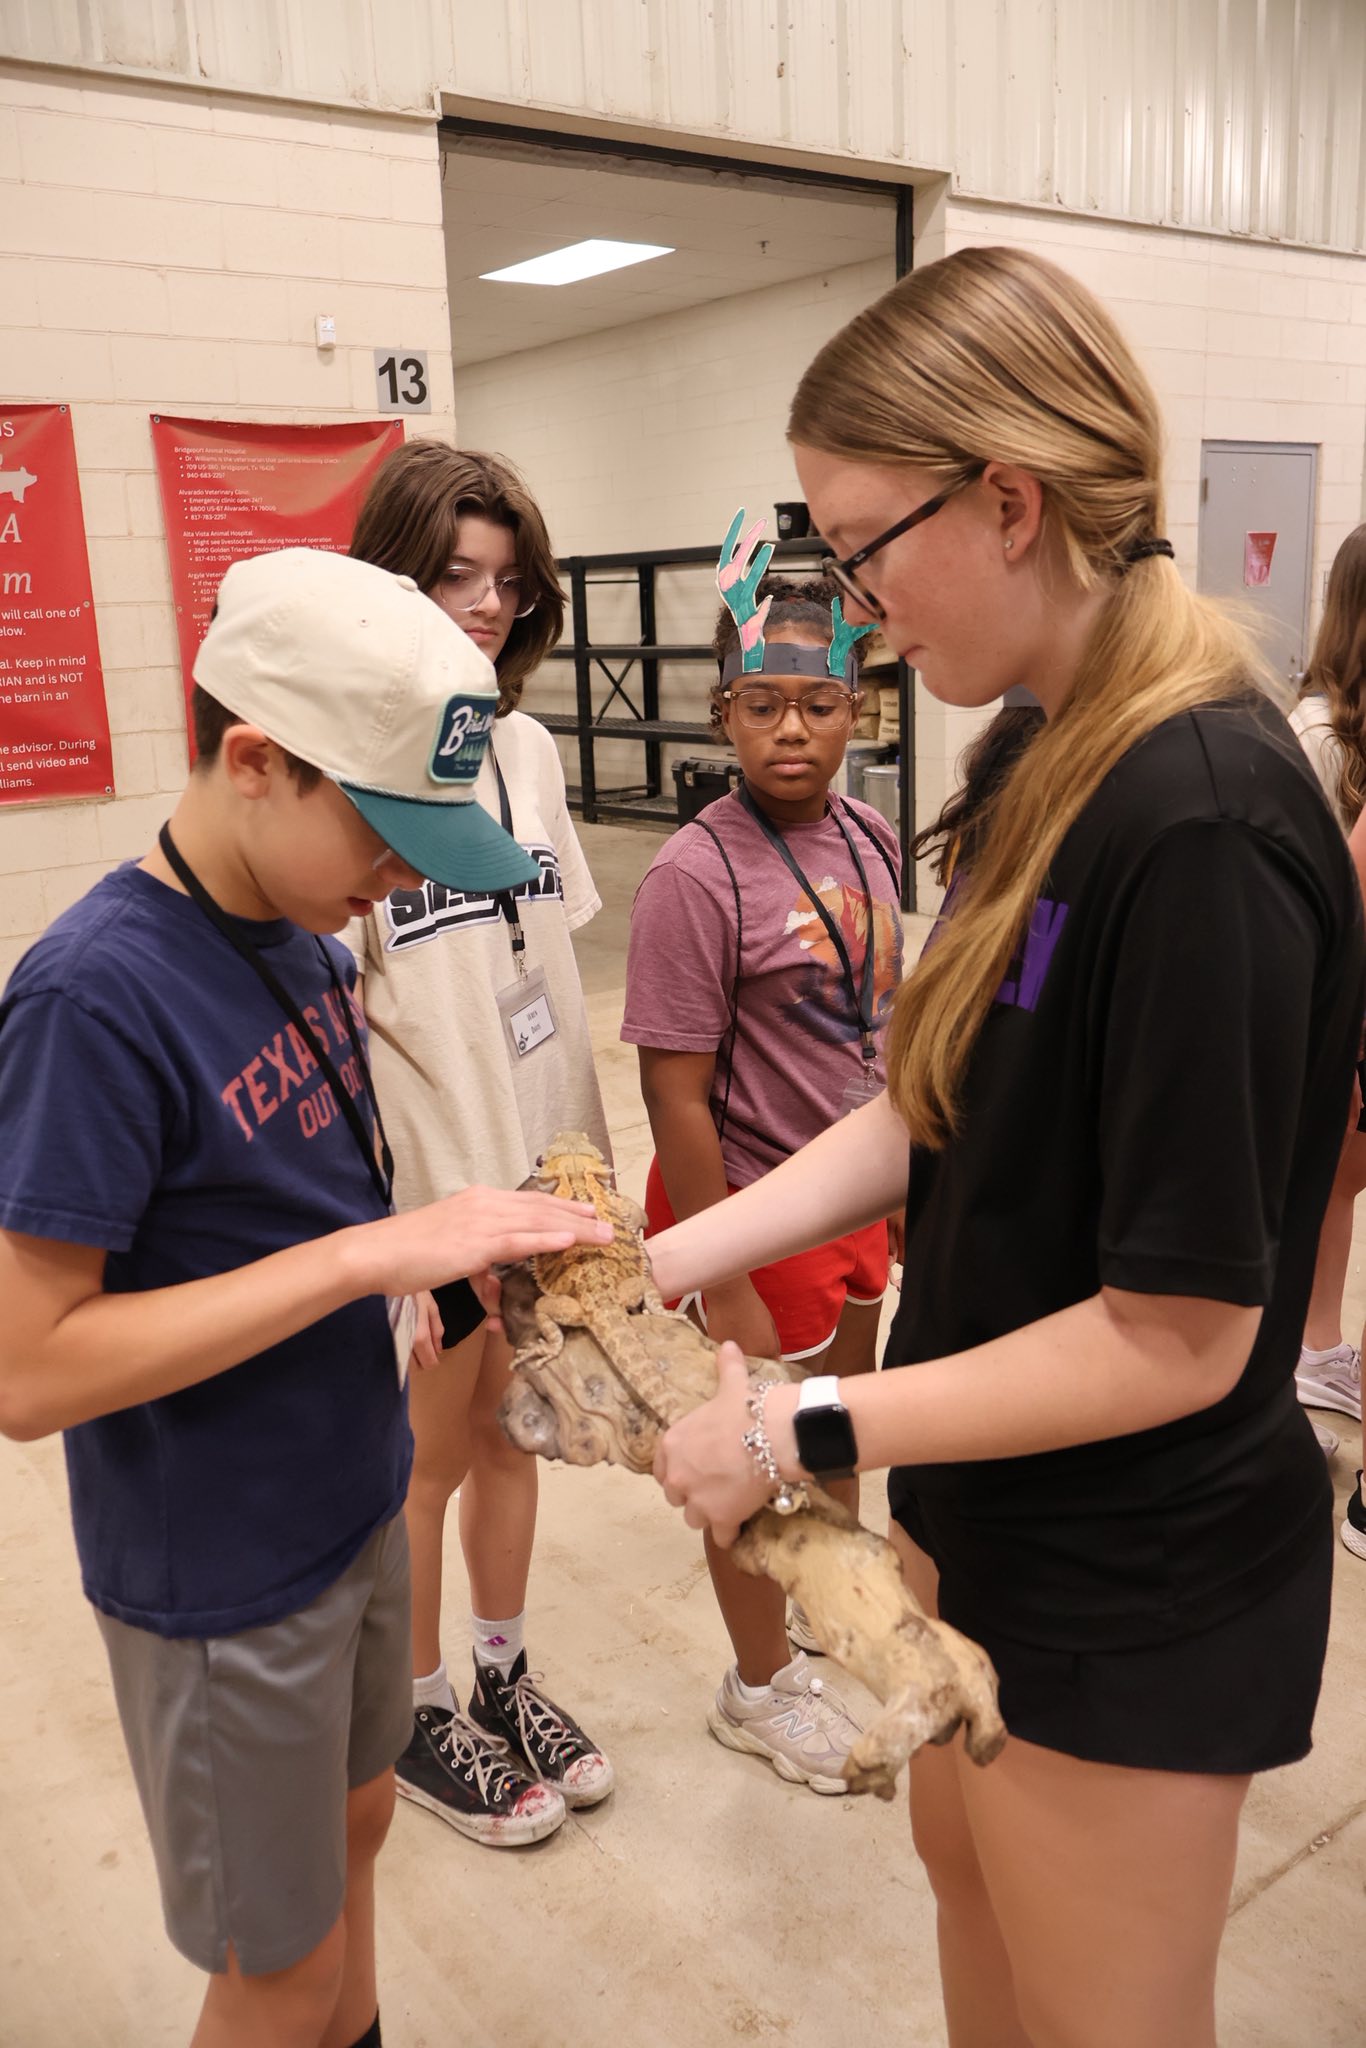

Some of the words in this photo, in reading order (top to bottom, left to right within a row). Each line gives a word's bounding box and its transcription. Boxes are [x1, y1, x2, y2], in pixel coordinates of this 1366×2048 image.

[378, 356, 427, 405] 13
[189, 497, 220, 505] Emergency
[267, 537, 284, 545] during
[230, 546, 253, 554] Triangle
[188, 572, 205, 580] Argyle
[2, 609, 22, 620] will
[23, 608, 44, 620] call
[45, 609, 67, 619] one
[68, 606, 81, 618] of
[15, 658, 43, 670] Keep
[45, 656, 56, 667] in
[58, 655, 87, 667] mind
[25, 674, 46, 686] and
[48, 672, 57, 684] is
[60, 672, 84, 684] NOT
[15, 692, 40, 703] barn
[42, 690, 53, 701] in
[55, 690, 69, 701] an
[12, 742, 57, 754] advisor.
[59, 739, 97, 751] During
[6, 759, 34, 772] send
[35, 757, 67, 770] video
[68, 754, 90, 766] and
[220, 1005, 331, 1143] TEXAS
